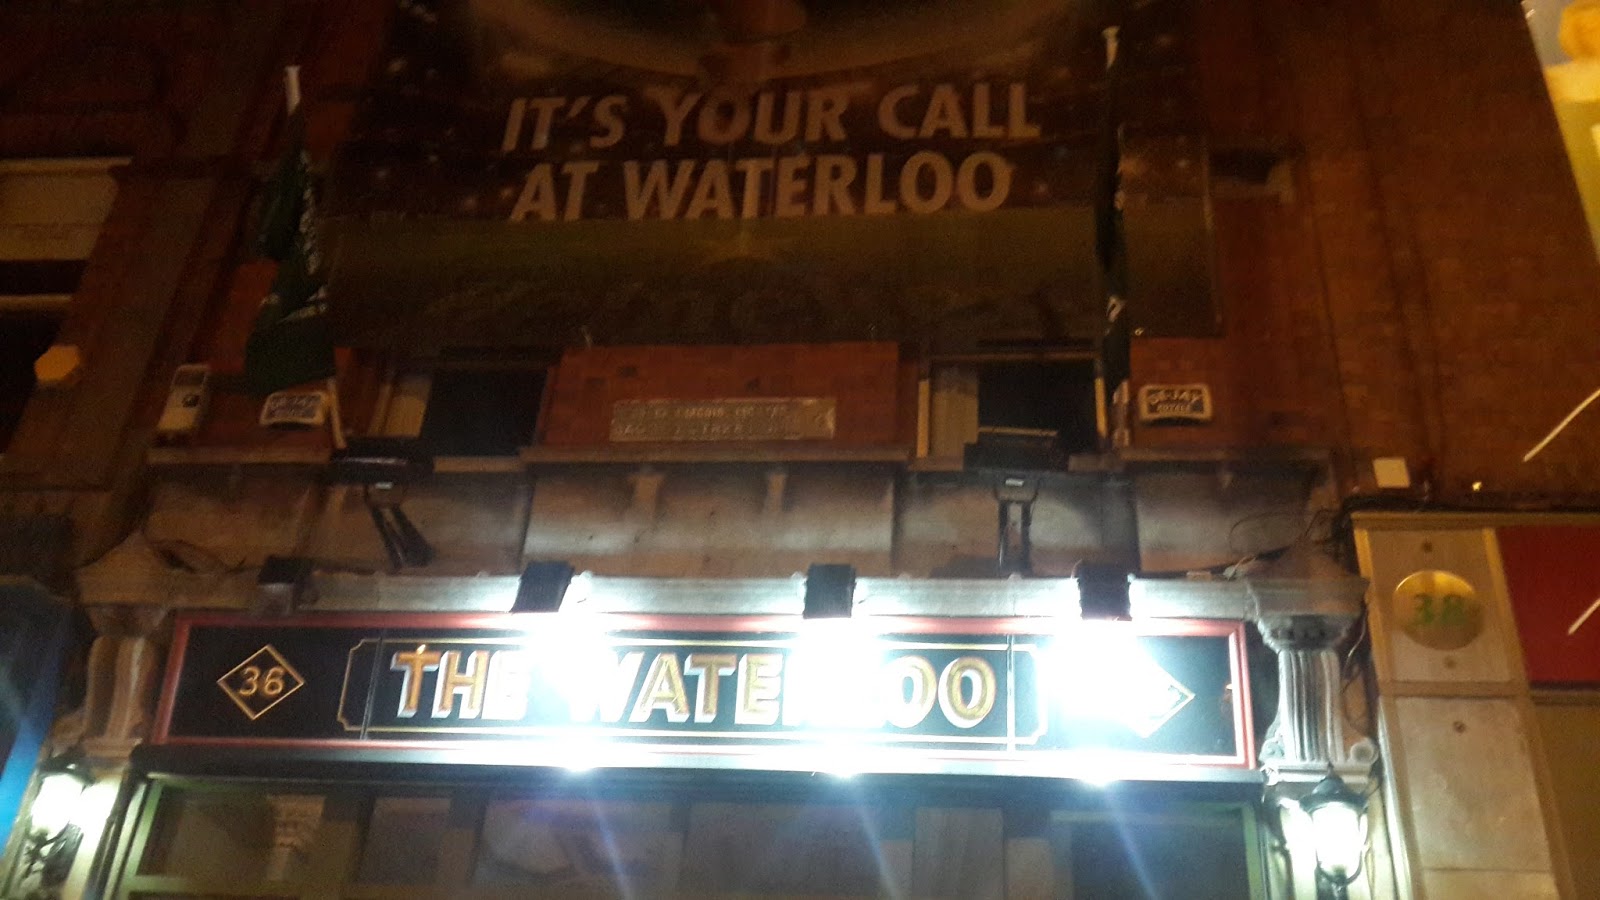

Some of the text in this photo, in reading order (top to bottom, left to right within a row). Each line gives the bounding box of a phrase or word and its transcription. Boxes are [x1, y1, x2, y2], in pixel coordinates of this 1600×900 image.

[502, 82, 1041, 152] IT'S YOUR CALL
[510, 150, 1016, 222] AT WATERLOO
[238, 665, 286, 698] 36
[390, 643, 998, 730] THE WATEOO
